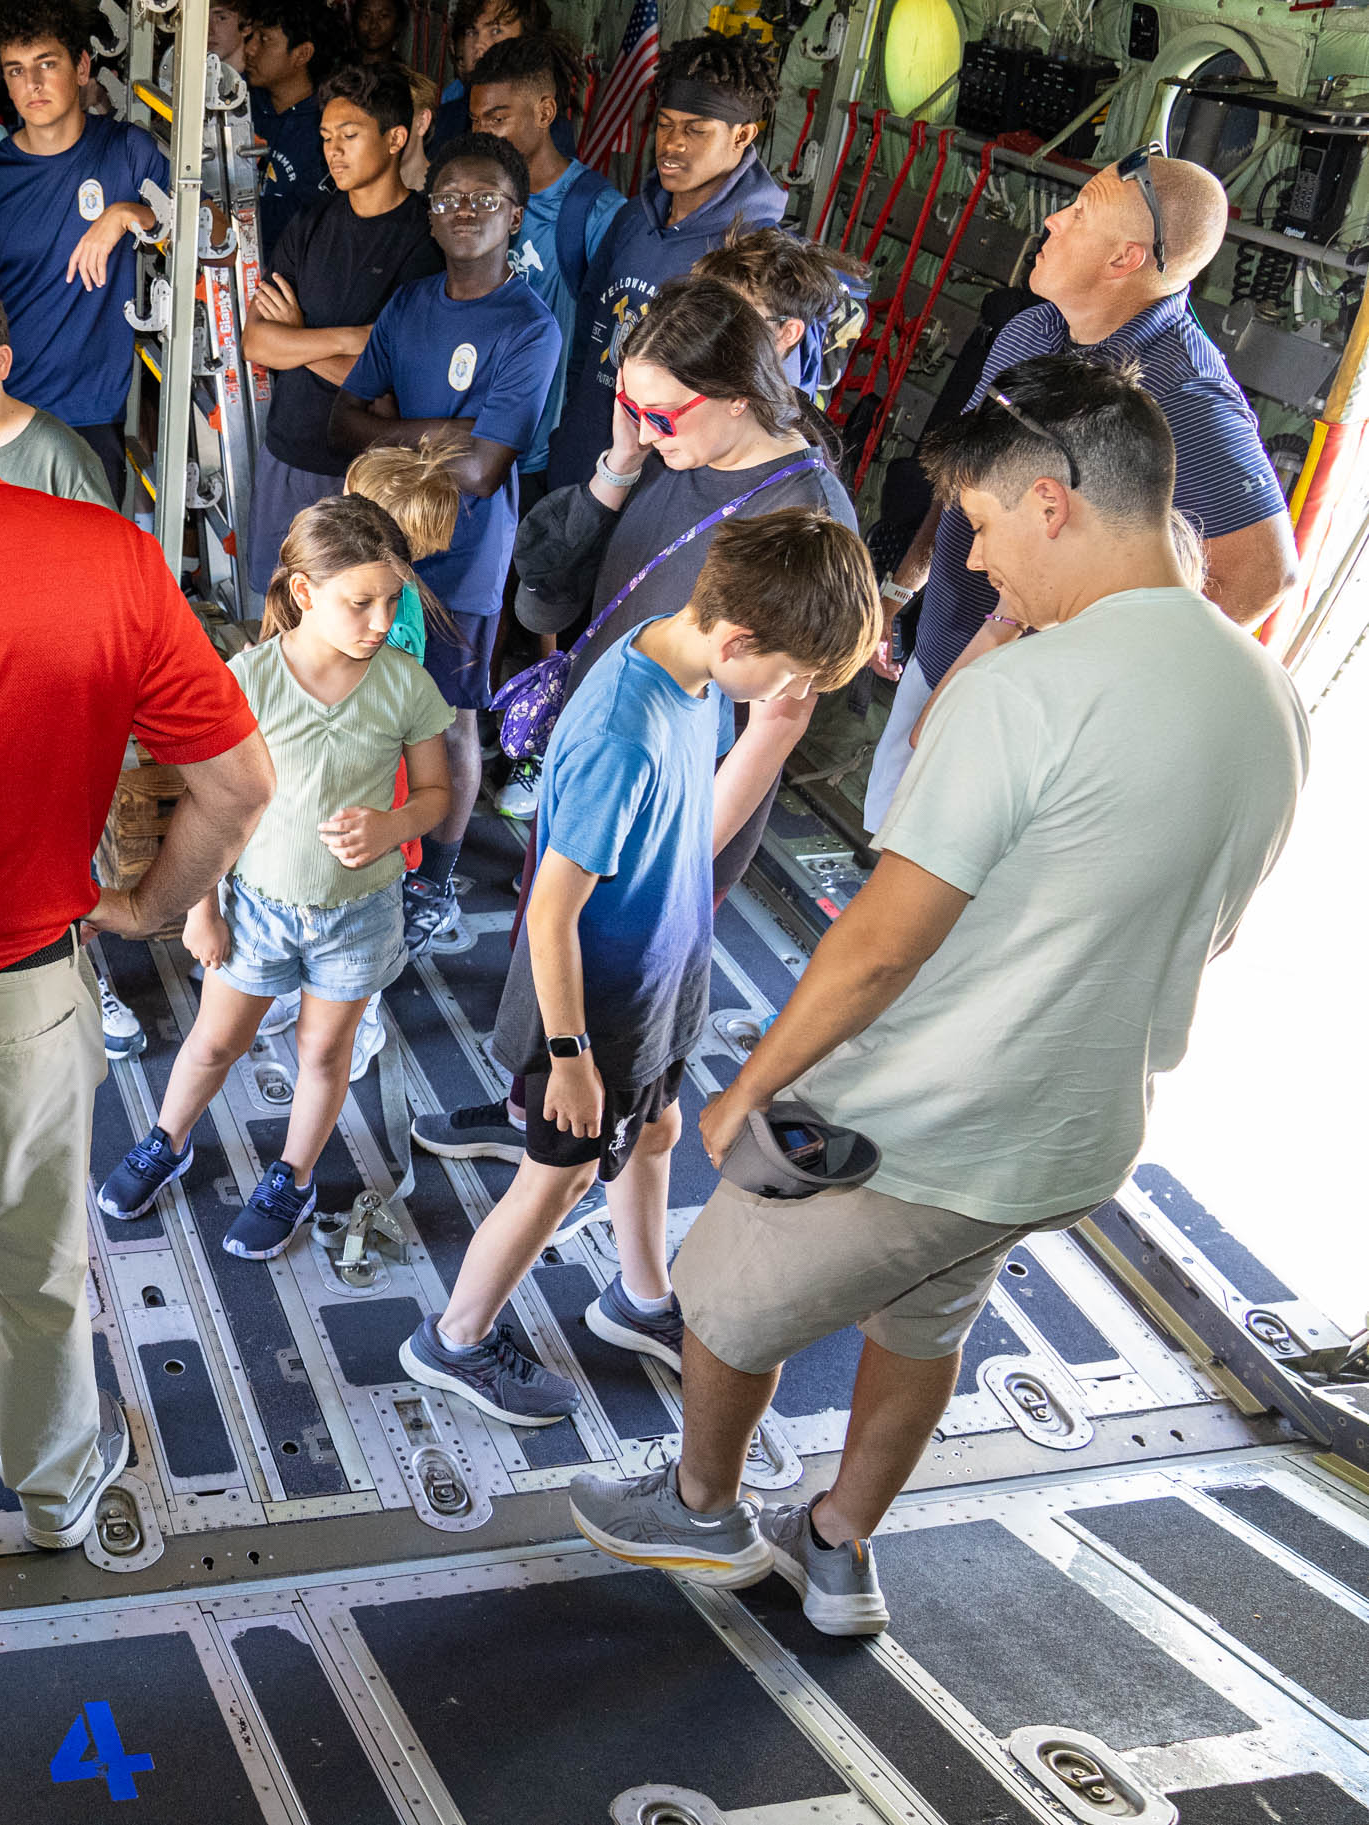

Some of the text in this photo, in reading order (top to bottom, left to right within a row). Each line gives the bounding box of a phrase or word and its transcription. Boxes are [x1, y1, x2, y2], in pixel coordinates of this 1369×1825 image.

[600, 277, 658, 304] YELLOWHA
[596, 371, 616, 389] FUTBO
[49, 1700, 155, 1802] 4
